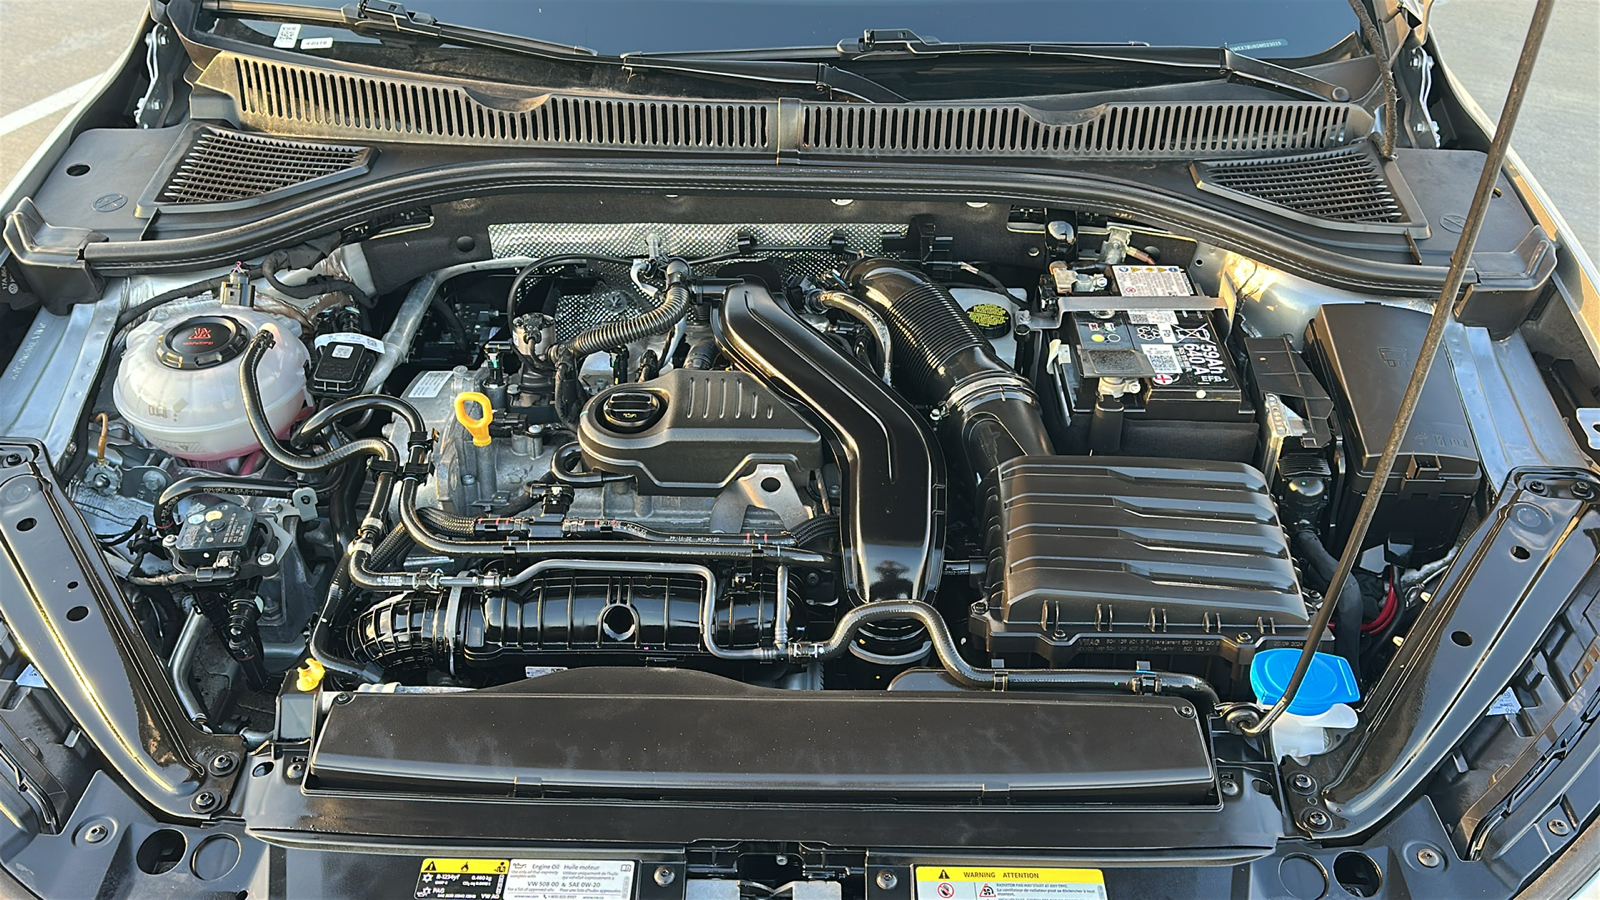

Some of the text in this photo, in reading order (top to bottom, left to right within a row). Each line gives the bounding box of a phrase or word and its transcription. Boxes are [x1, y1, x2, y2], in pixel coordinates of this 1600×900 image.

[1183, 343, 1206, 364] 640
[1200, 344, 1227, 374] 59Ah
[1192, 365, 1210, 375] A
